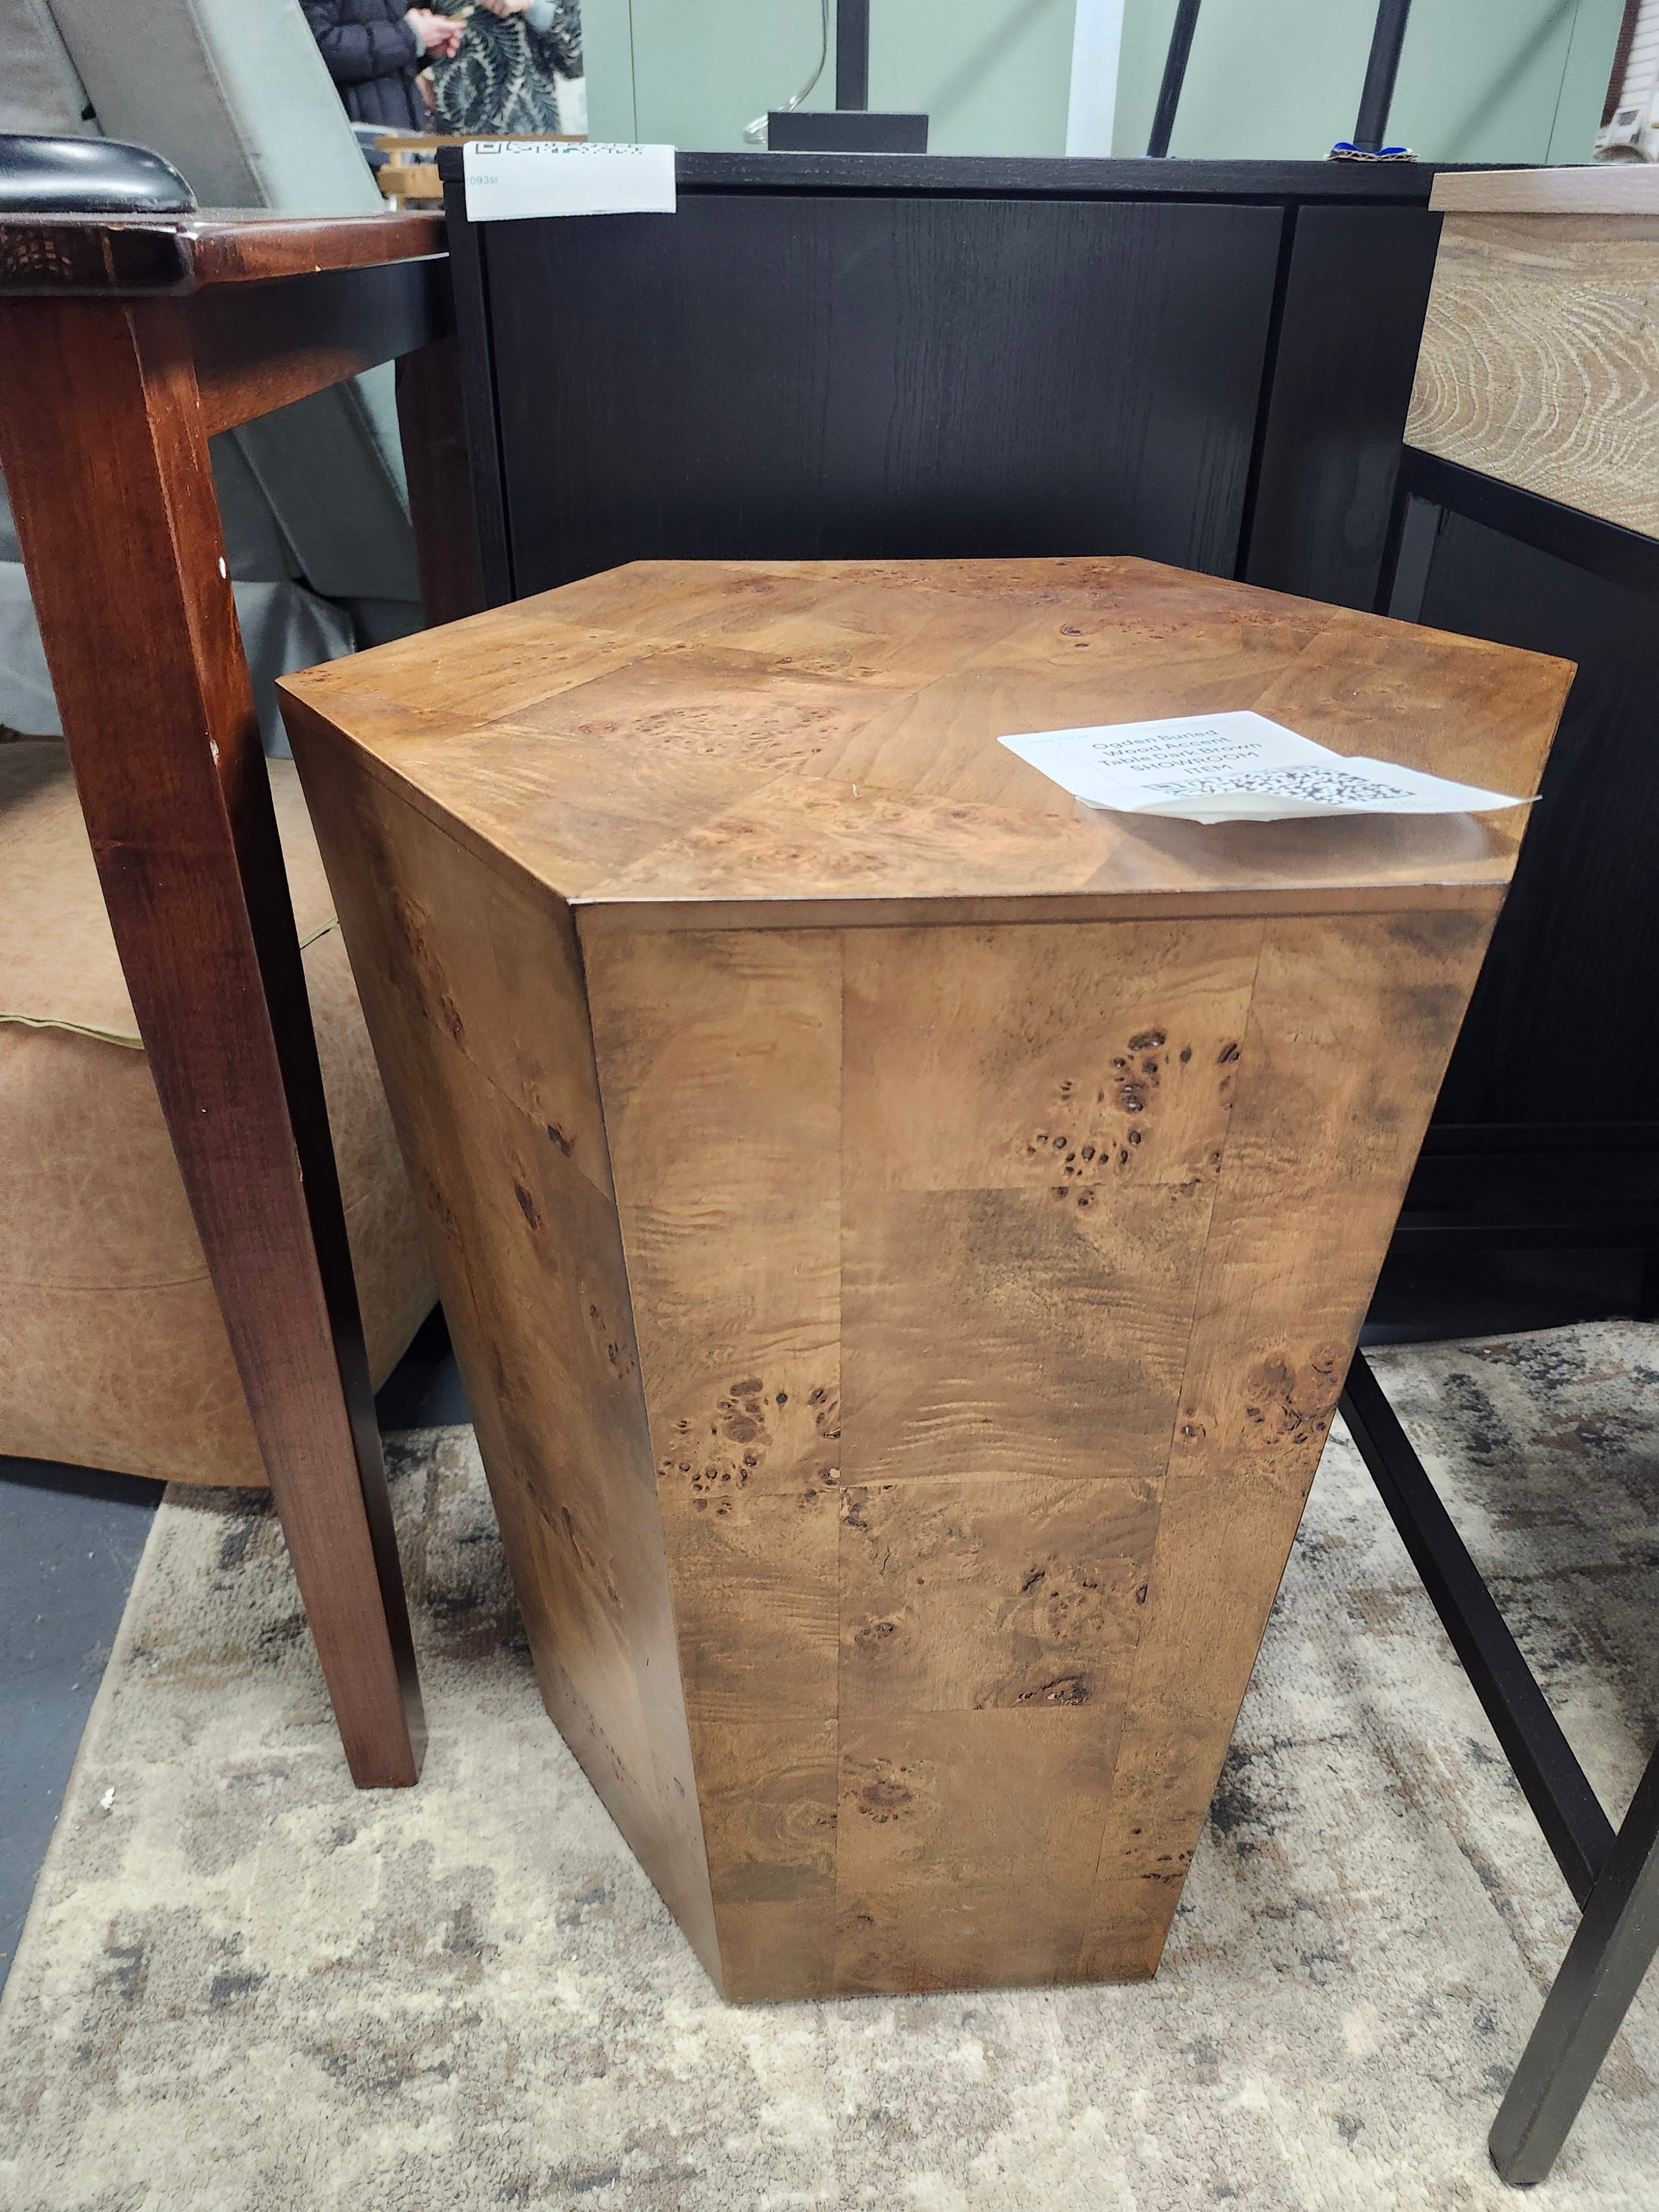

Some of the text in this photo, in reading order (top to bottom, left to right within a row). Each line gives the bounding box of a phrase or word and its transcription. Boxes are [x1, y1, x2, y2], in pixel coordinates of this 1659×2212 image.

[1092, 738, 1157, 749] Ogden
[1157, 730, 1219, 741] Burled
[1103, 737, 1232, 756] Wood Accent
[1097, 743, 1263, 766] Table Dark Brown
[1130, 752, 1260, 771] SHOWROOM
[1183, 764, 1234, 775] ITEM
